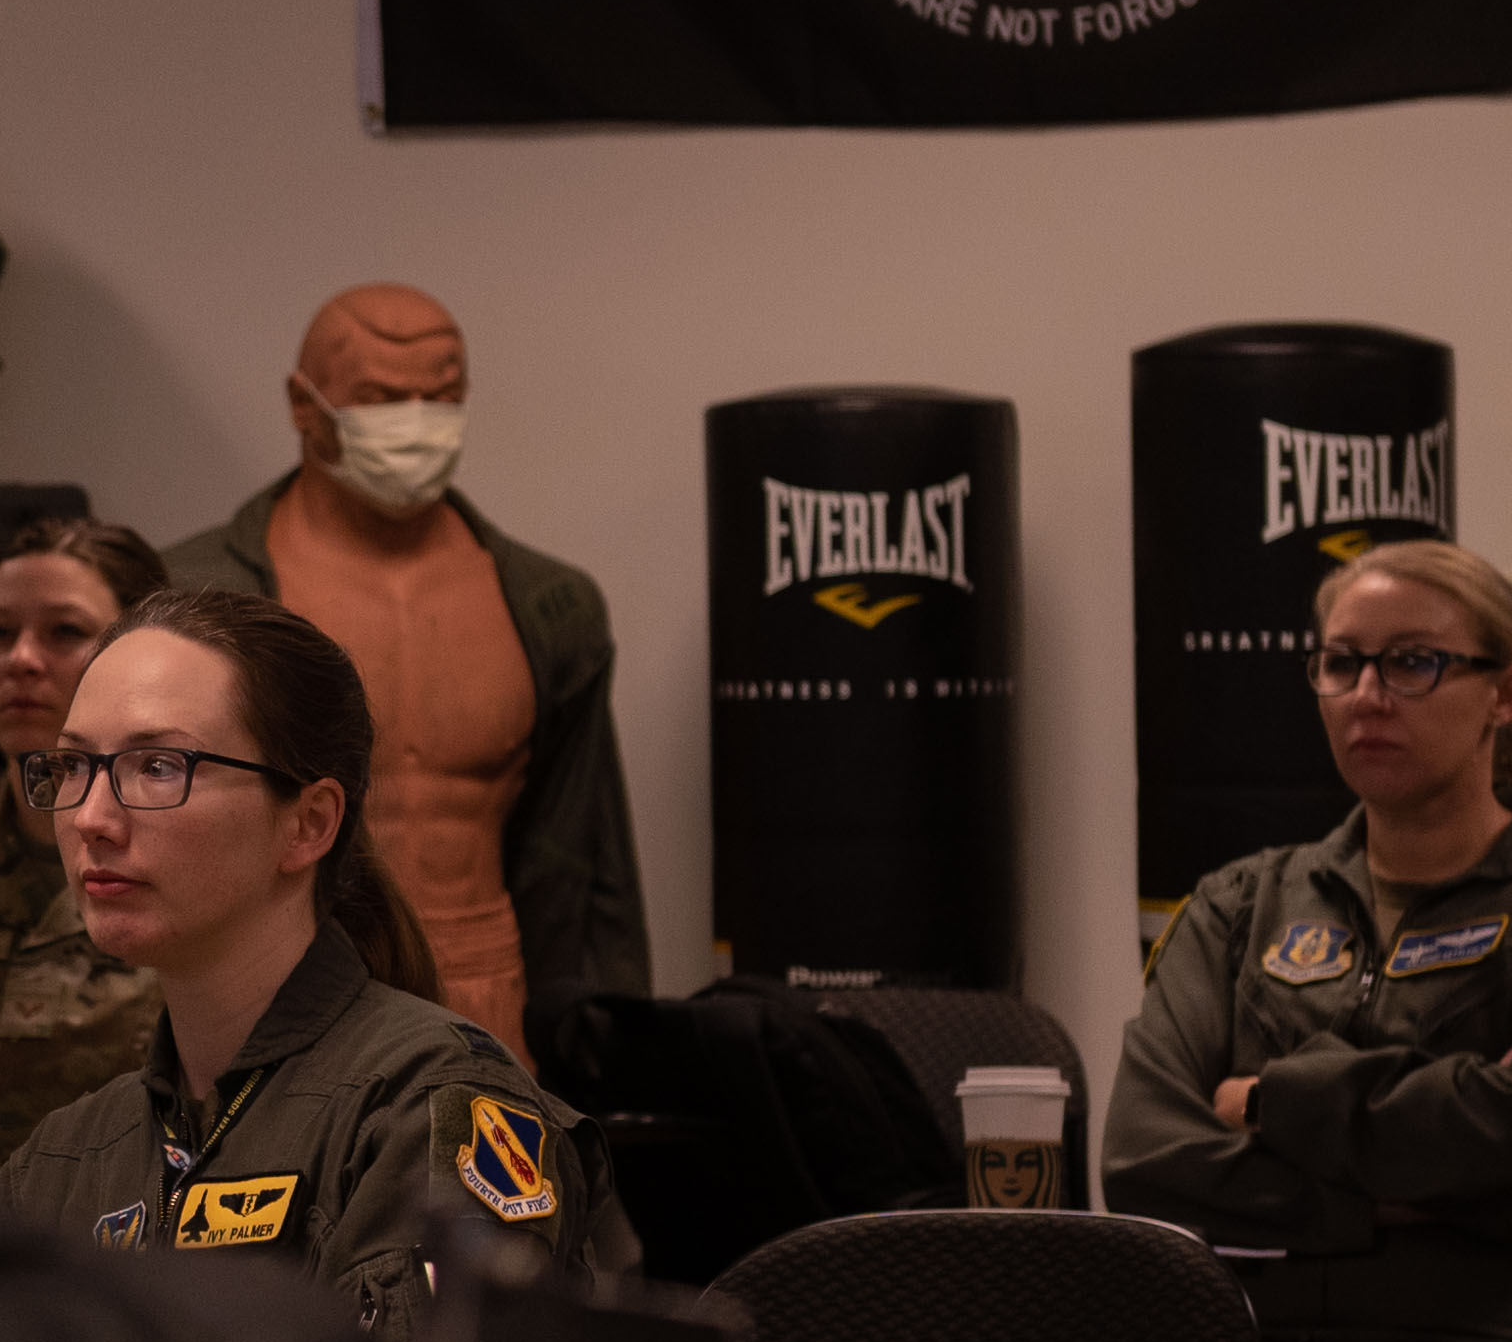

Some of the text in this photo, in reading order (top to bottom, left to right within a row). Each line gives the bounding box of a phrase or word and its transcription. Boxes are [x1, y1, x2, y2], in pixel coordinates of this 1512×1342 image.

[985, 4, 1059, 48] NOT
[1260, 417, 1449, 545] EVERLAST
[760, 471, 975, 597] EVERLAST
[463, 1166, 502, 1207] FOURTH
[501, 1202, 525, 1215] BUT
[207, 1223, 274, 1243] IVY PALMER
